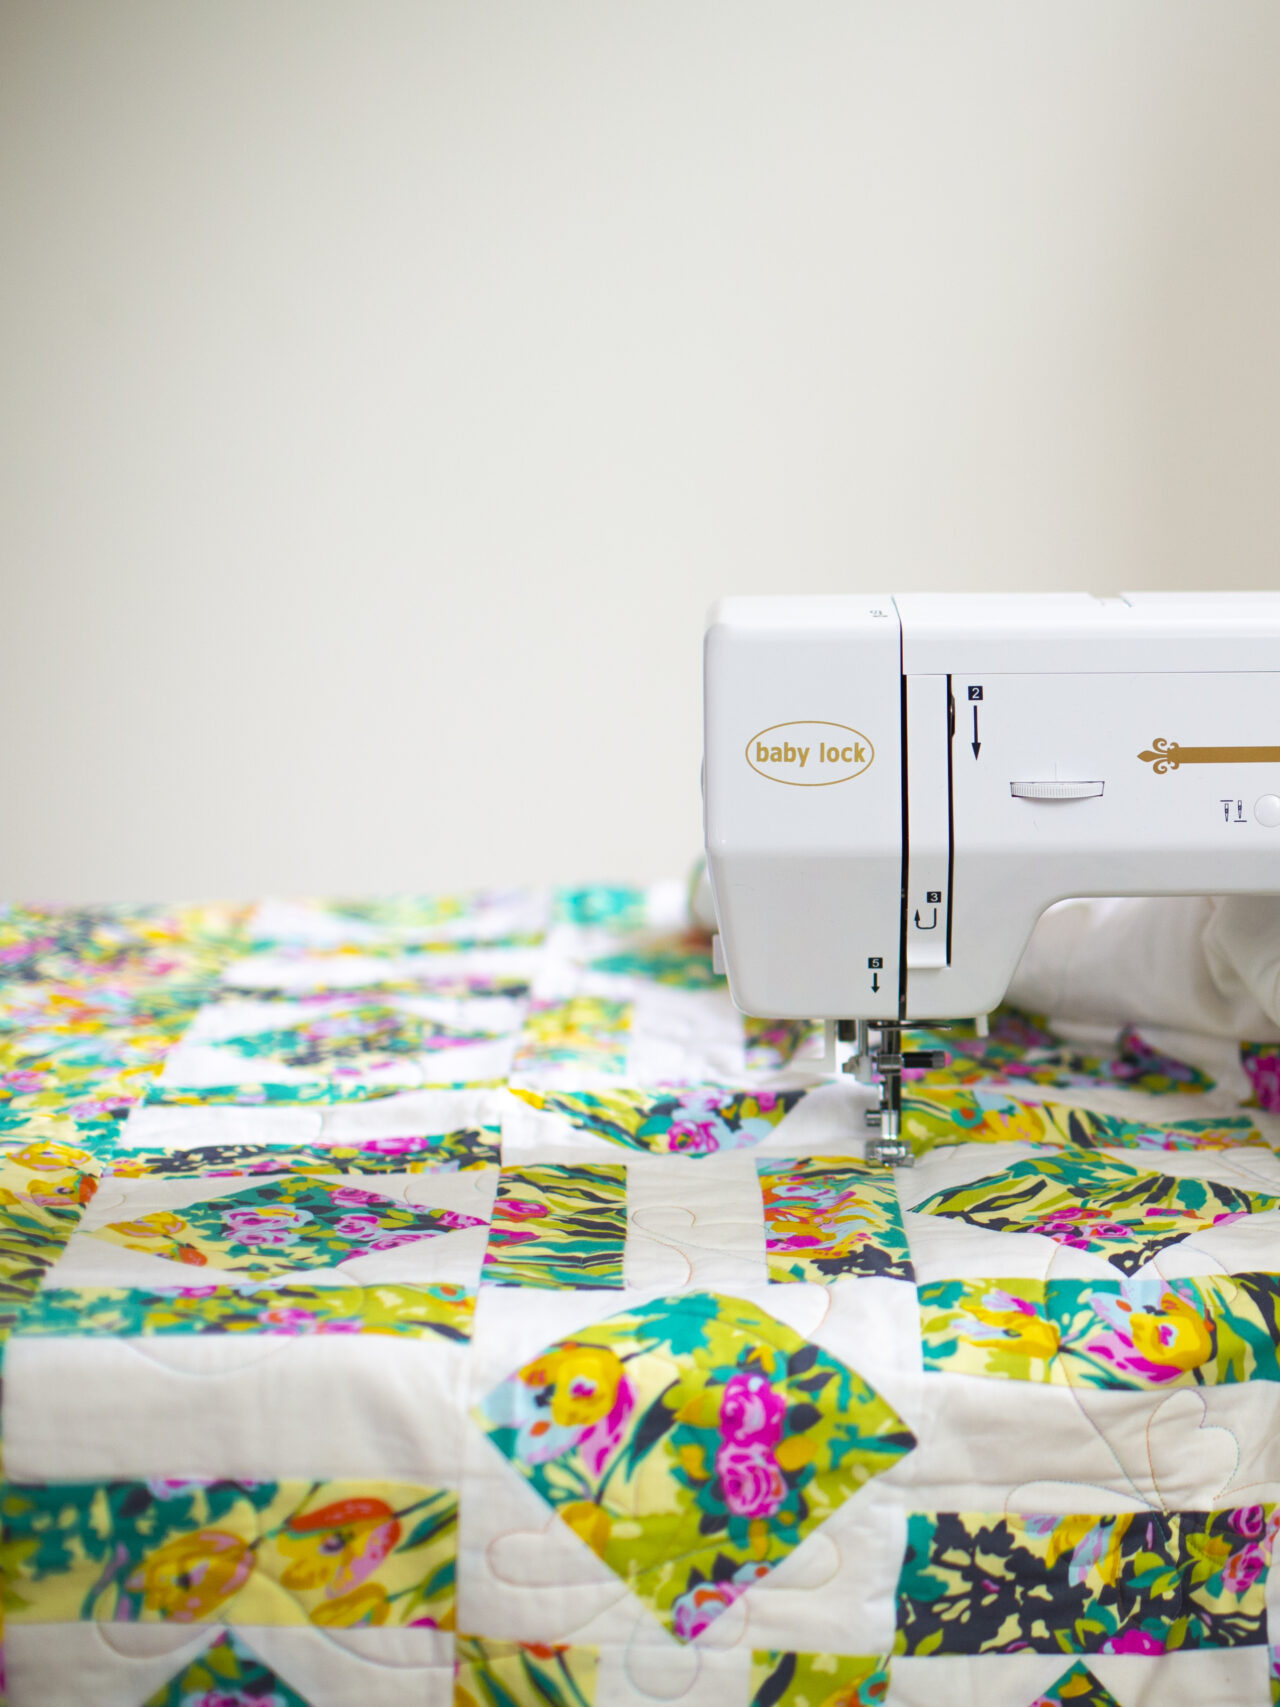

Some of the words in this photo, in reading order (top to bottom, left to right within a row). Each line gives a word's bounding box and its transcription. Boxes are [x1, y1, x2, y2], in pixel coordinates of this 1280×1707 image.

[971, 687, 981, 699] 2
[756, 742, 810, 767] baby
[819, 742, 866, 763] lock
[929, 892, 939, 902] 3
[871, 958, 881, 968] 5
